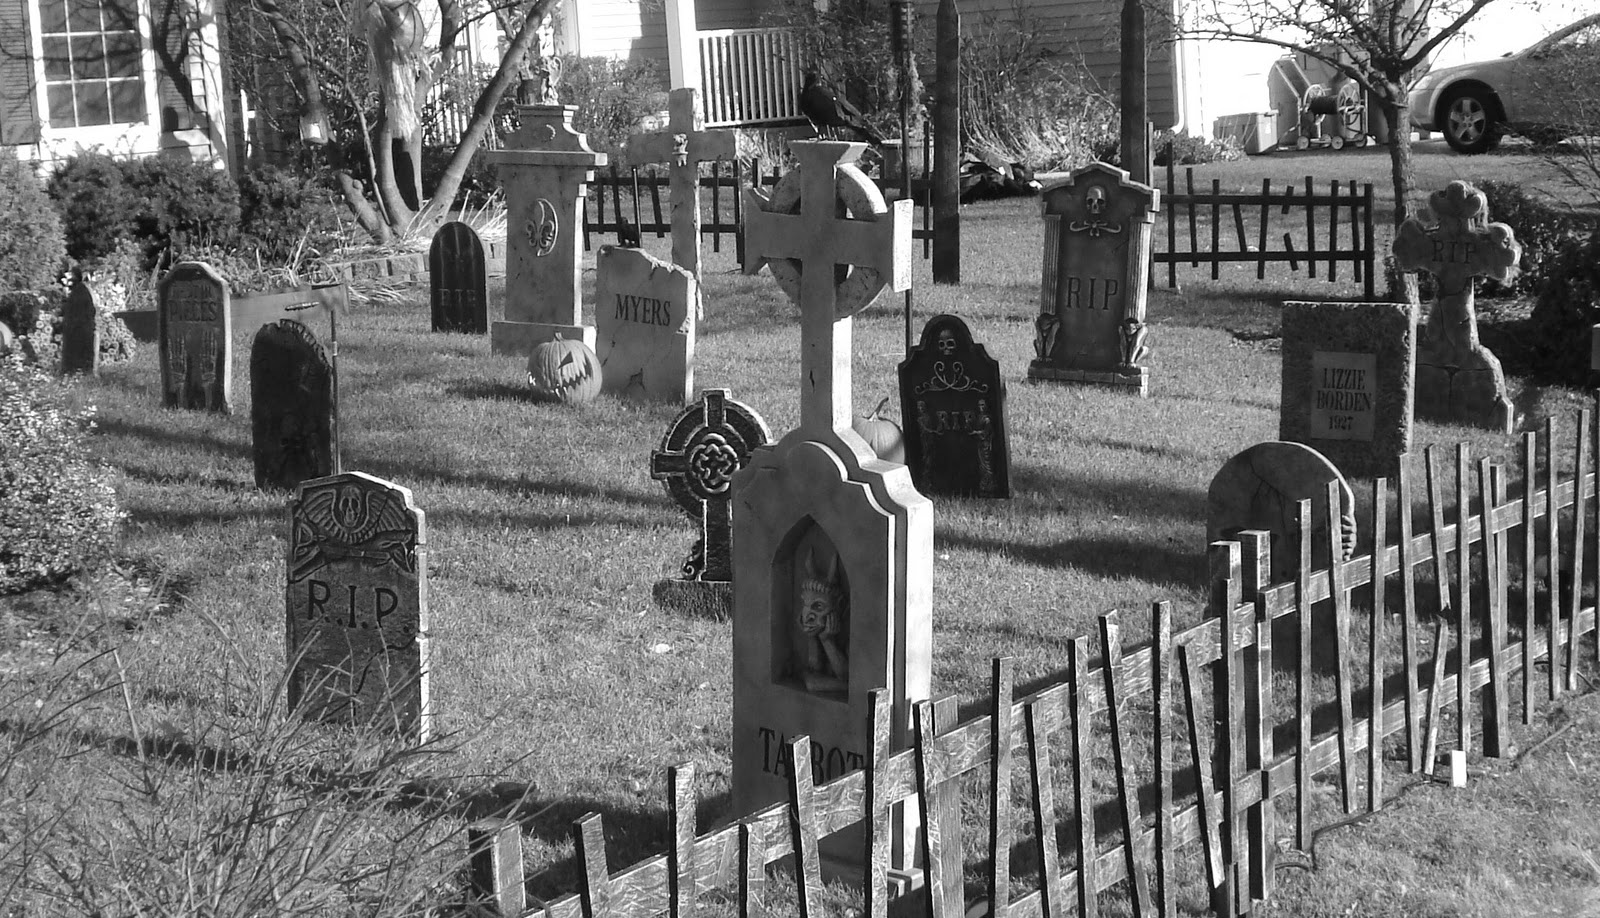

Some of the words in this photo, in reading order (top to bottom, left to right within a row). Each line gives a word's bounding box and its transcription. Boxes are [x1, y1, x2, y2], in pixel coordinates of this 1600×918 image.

[1431, 239, 1477, 264] RIP
[1066, 276, 1118, 310] RIP
[168, 300, 217, 322] PIECES
[615, 293, 671, 326] MYERS
[1322, 367, 1366, 390] LIZZIE
[1316, 390, 1372, 412] BORDEN
[1328, 415, 1355, 431] 1927
[758, 726, 865, 787] TABOT
